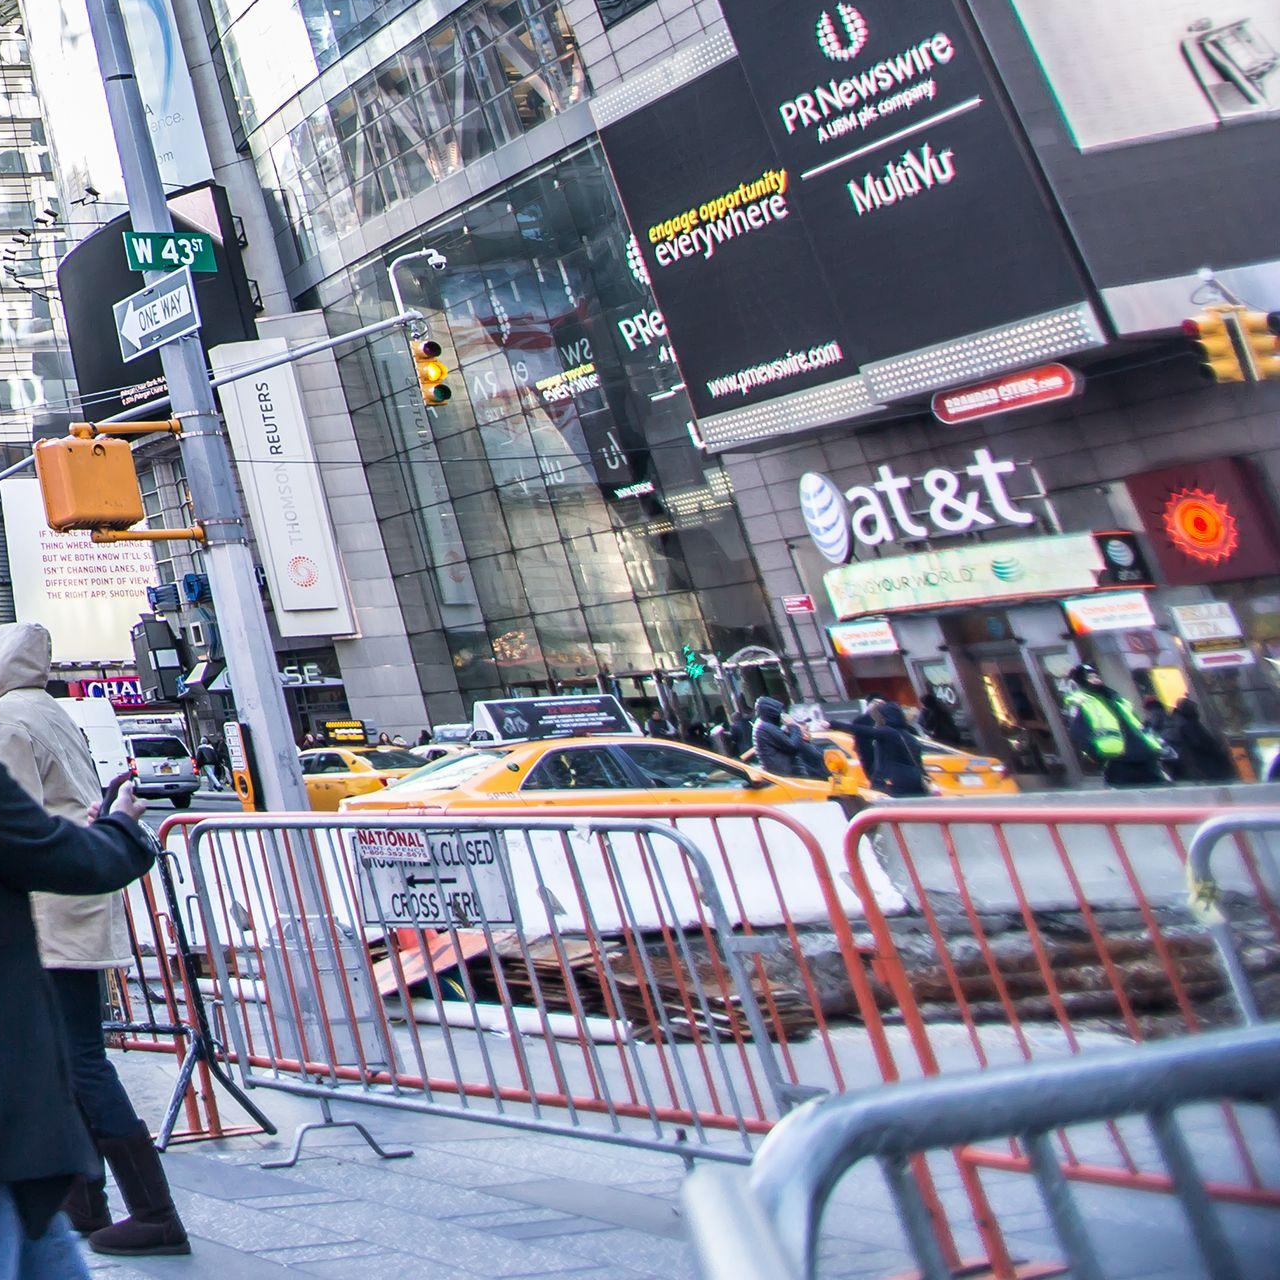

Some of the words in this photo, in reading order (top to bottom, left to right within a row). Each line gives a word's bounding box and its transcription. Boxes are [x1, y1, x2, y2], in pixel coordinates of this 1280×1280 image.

[817, 125, 829, 144] A
[827, 112, 858, 138] UBM
[876, 76, 938, 114] company
[847, 141, 958, 217] MultiVu
[647, 206, 700, 245] engage
[698, 167, 789, 224] opportunity
[653, 192, 790, 268] everywhere
[131, 237, 153, 264] W
[137, 302, 162, 333] ONE
[161, 288, 187, 318] WAY
[942, 384, 1000, 415] BRANDED
[257, 380, 284, 457] REUTERS
[844, 447, 1035, 548] at&t
[41, 542, 63, 550] THING
[42, 554, 57, 562] BUT
[60, 554, 72, 562] WE
[75, 553, 95, 561] BOTH
[97, 553, 120, 561] KNOW
[44, 566, 64, 574] ISN'T
[67, 565, 107, 574] CHANGING
[46, 578, 88, 587] DIFFERENT
[91, 577, 114, 586] POINT
[47, 591, 62, 599] THE
[65, 591, 88, 599] RIGHT
[110, 589, 146, 598] SHOTGUN
[357, 830, 424, 847] NATIONAL
[391, 893, 440, 918] CROSS
